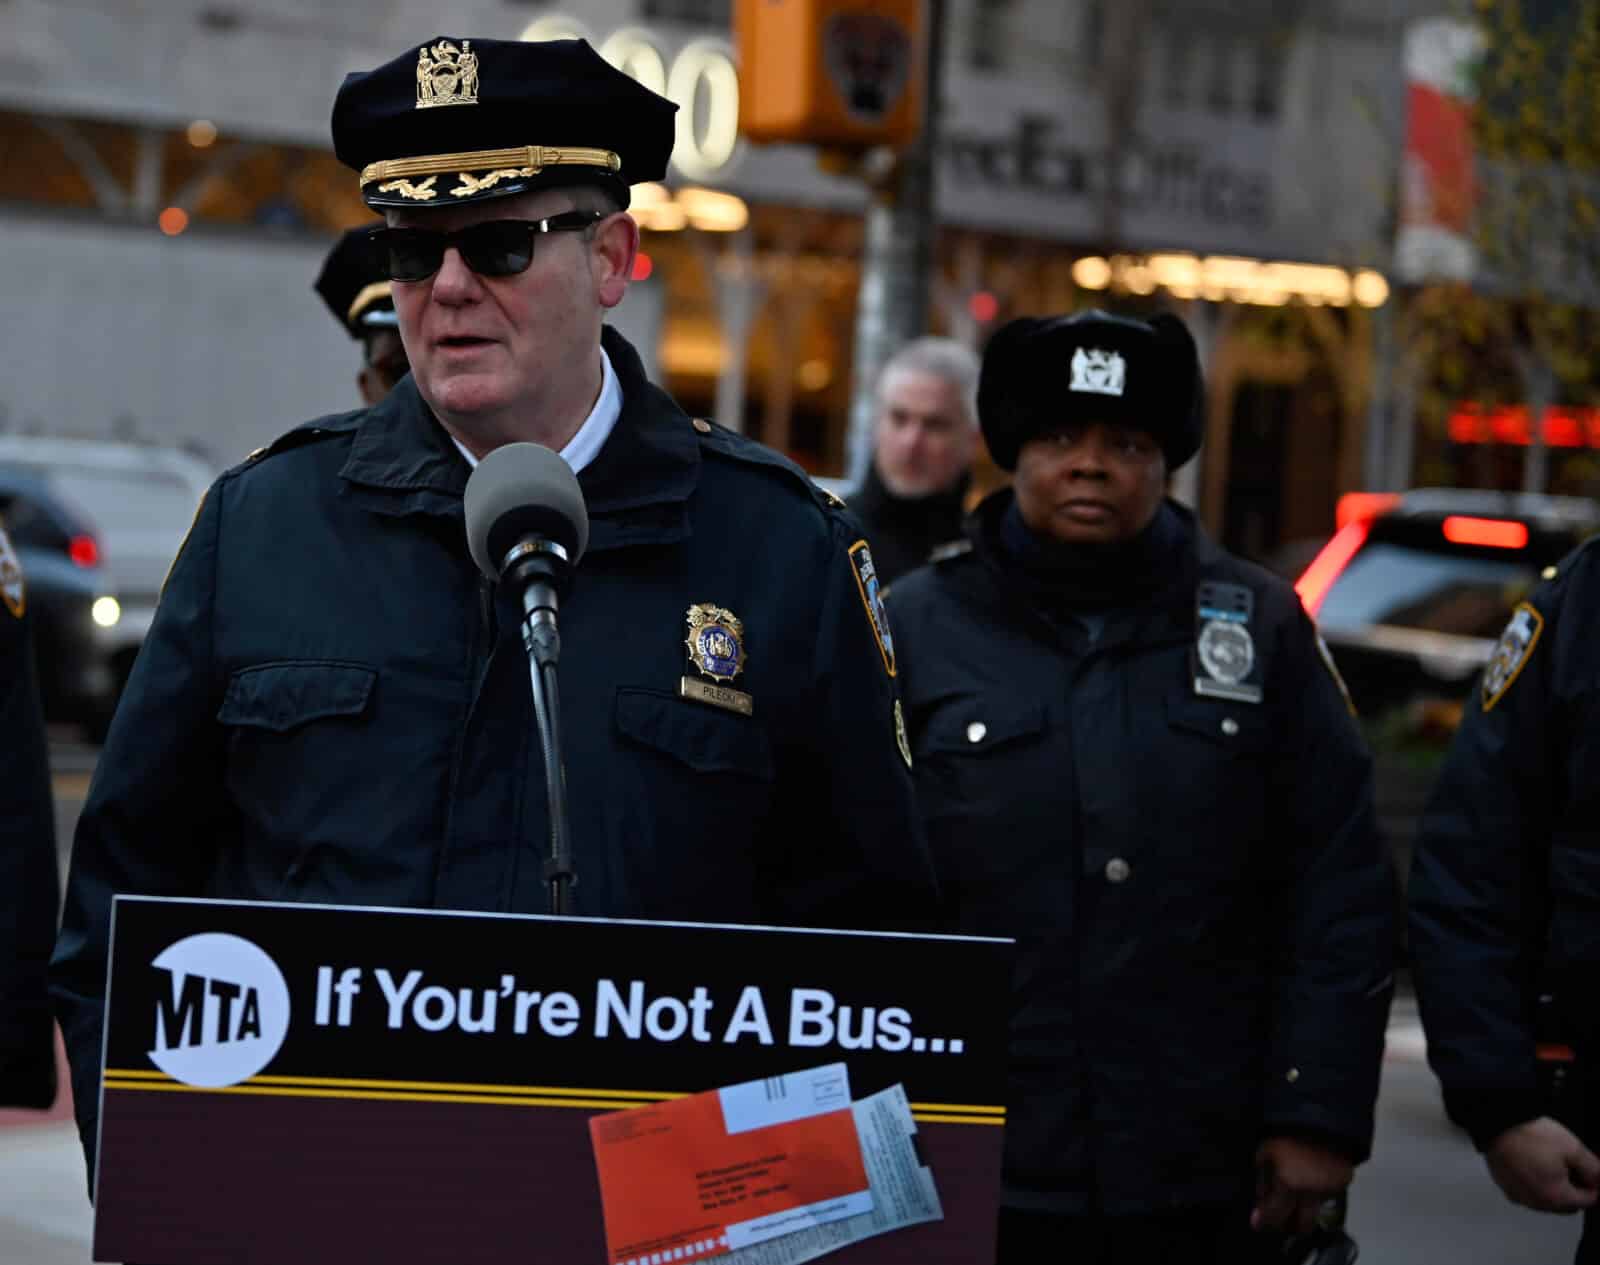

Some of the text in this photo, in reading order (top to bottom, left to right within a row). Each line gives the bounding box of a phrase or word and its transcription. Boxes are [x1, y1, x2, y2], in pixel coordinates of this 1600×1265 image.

[149, 965, 261, 1053] MTA
[315, 966, 964, 1053] If You’re Not A Bus...
